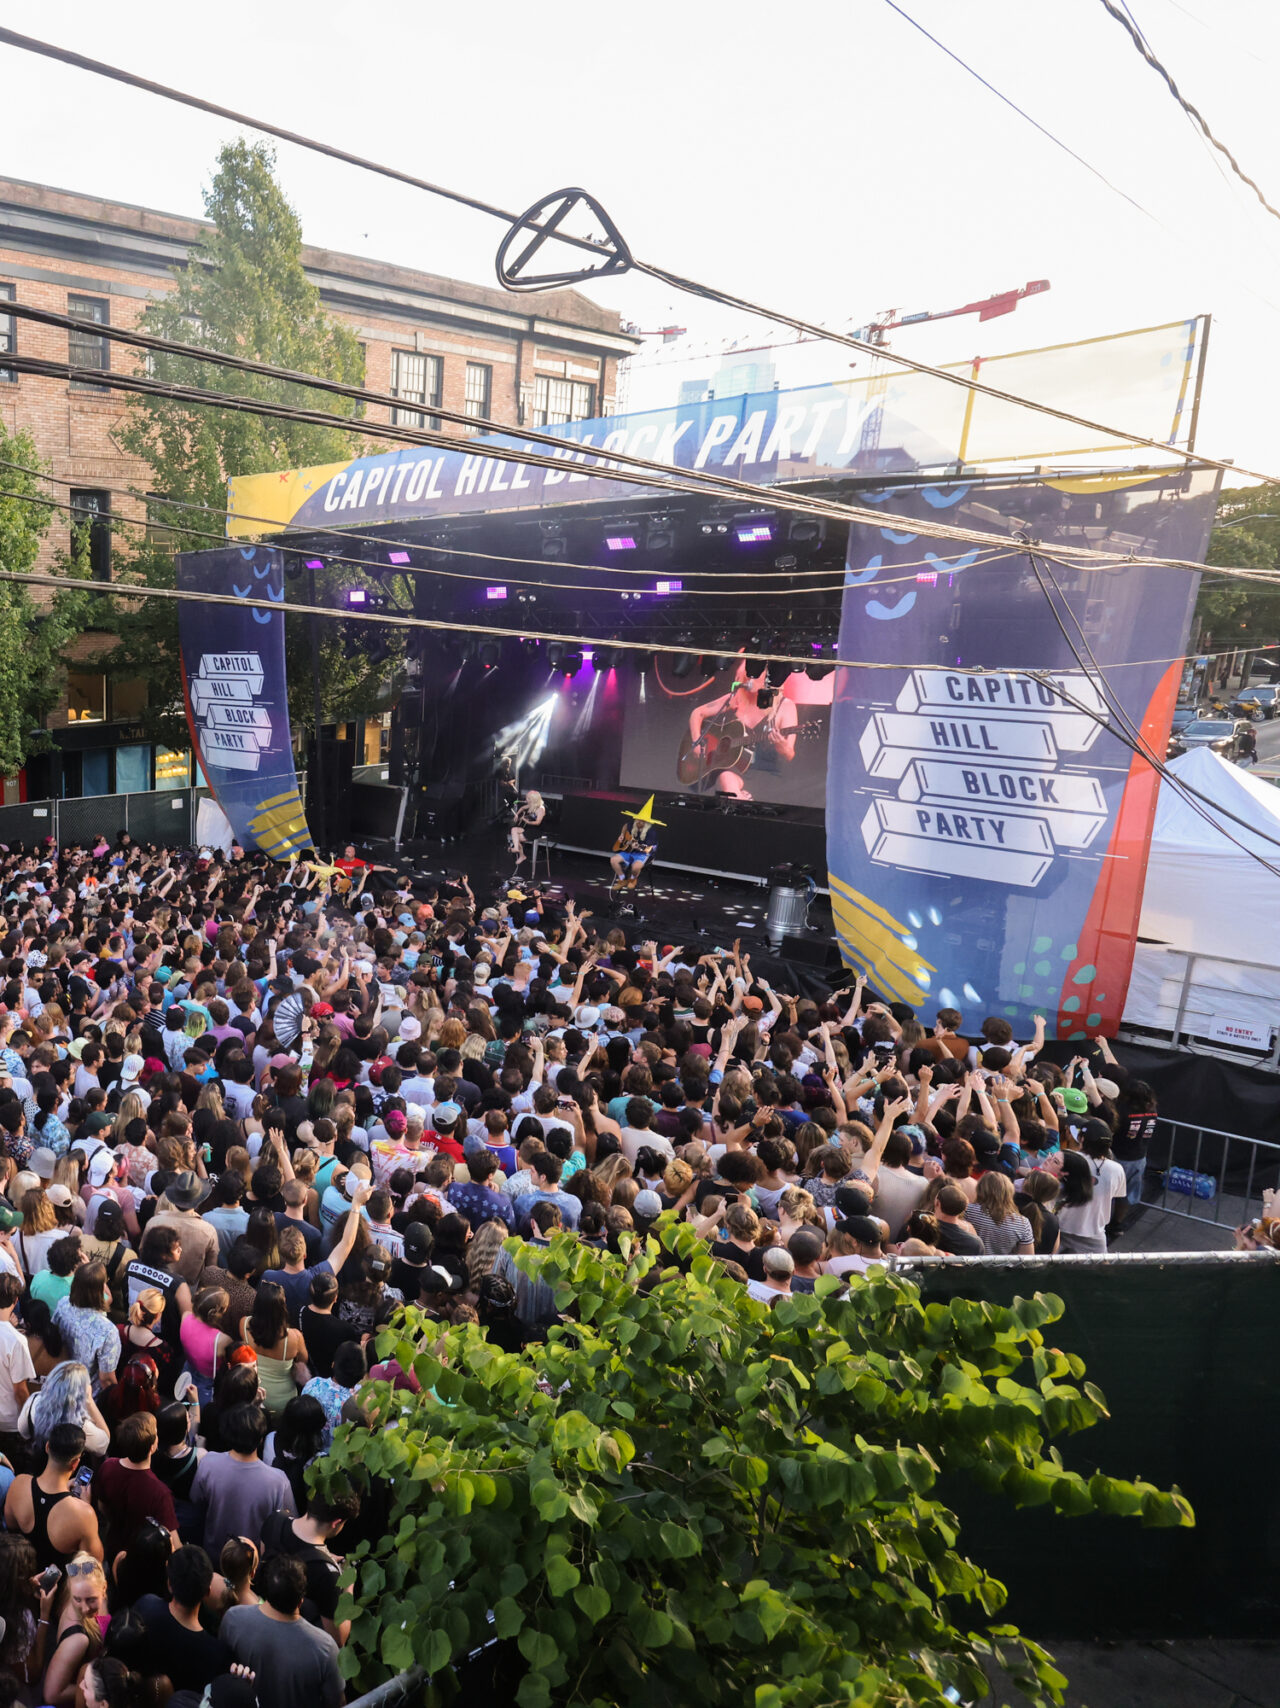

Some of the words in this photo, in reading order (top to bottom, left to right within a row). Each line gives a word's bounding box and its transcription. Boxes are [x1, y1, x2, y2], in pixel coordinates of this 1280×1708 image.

[324, 456, 447, 513] CAPITOL
[454, 440, 540, 497] HILL
[543, 420, 695, 486] BLOCK
[693, 395, 881, 469] PARTY
[213, 656, 255, 671] CAPITOL
[211, 682, 235, 697] HILL
[945, 676, 1073, 708] CAPITOL
[225, 708, 257, 724] BLOCK
[214, 732, 245, 749] PARTY
[929, 721, 999, 751] HILL
[961, 769, 1060, 804] BLOCK
[915, 809, 1006, 844] PARTY
[1234, 1027, 1255, 1036] ENTRY
